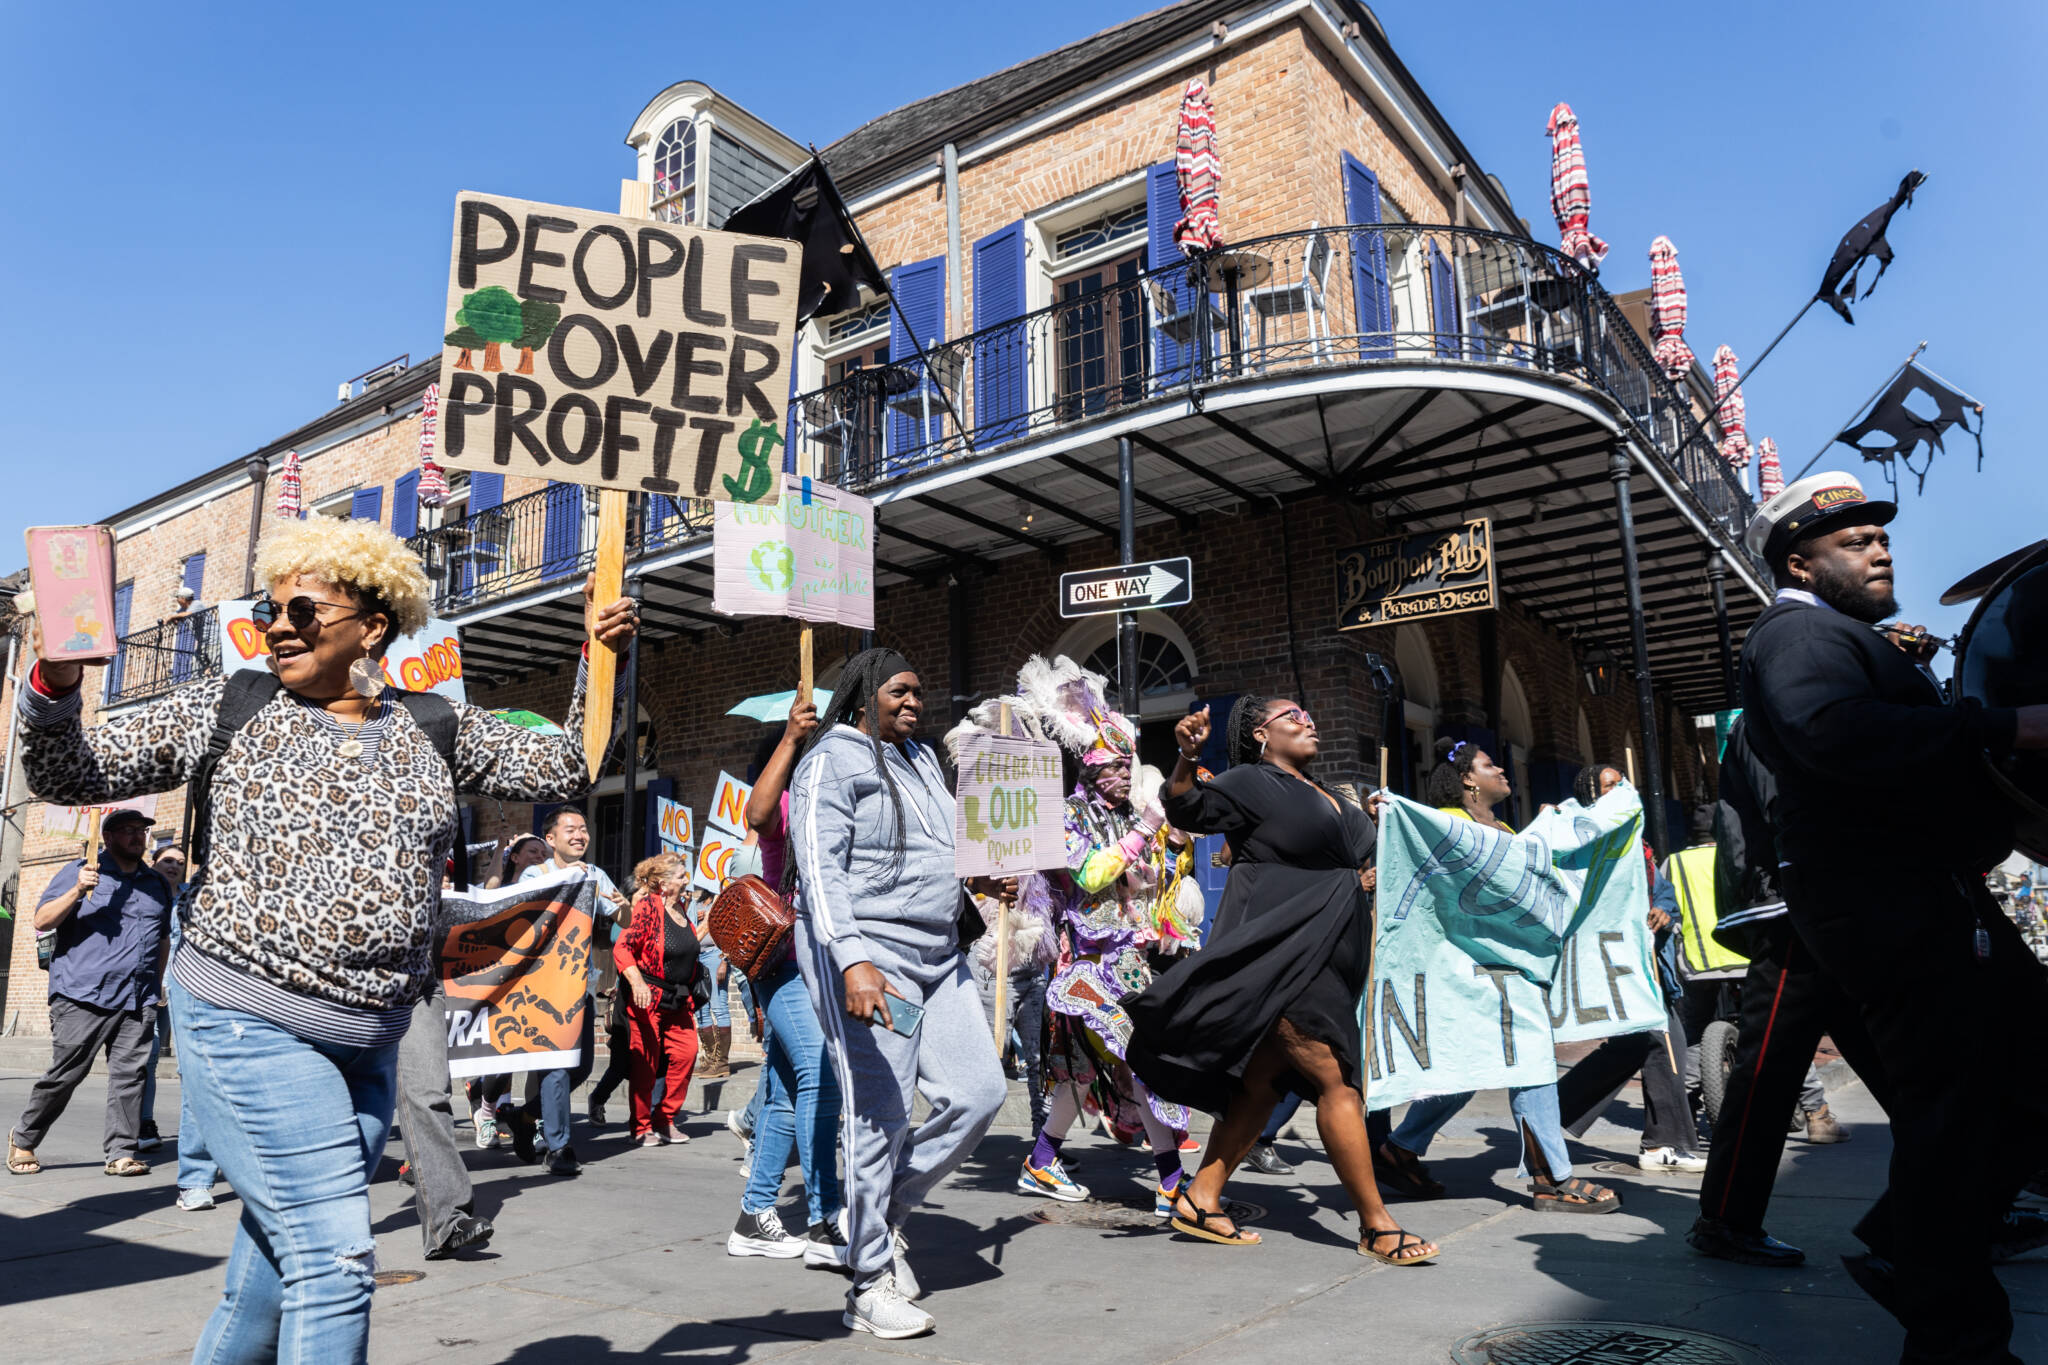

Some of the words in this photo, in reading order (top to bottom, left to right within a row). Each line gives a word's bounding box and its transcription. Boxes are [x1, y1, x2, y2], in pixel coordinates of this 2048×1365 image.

[457, 199, 788, 336] PEOPLE
[547, 313, 780, 422] OVER
[734, 494, 867, 550] ANOTHER
[1337, 535, 1433, 622] Bourbon
[1430, 522, 1488, 581] Pub
[1370, 543, 1393, 558] THE
[1075, 582, 1108, 602] ONE
[1115, 576, 1150, 596] WAY
[1358, 607, 1373, 622] &
[1438, 588, 1489, 610] DISCO
[975, 750, 1061, 785] CELEBRATE
[661, 804, 691, 844] NO
[716, 780, 749, 834] N
[988, 784, 1039, 832] OUR
[987, 837, 1033, 862] POWER
[1371, 973, 1432, 1081] IN
[1541, 927, 1634, 1029] ULF
[444, 1006, 491, 1048] RA
